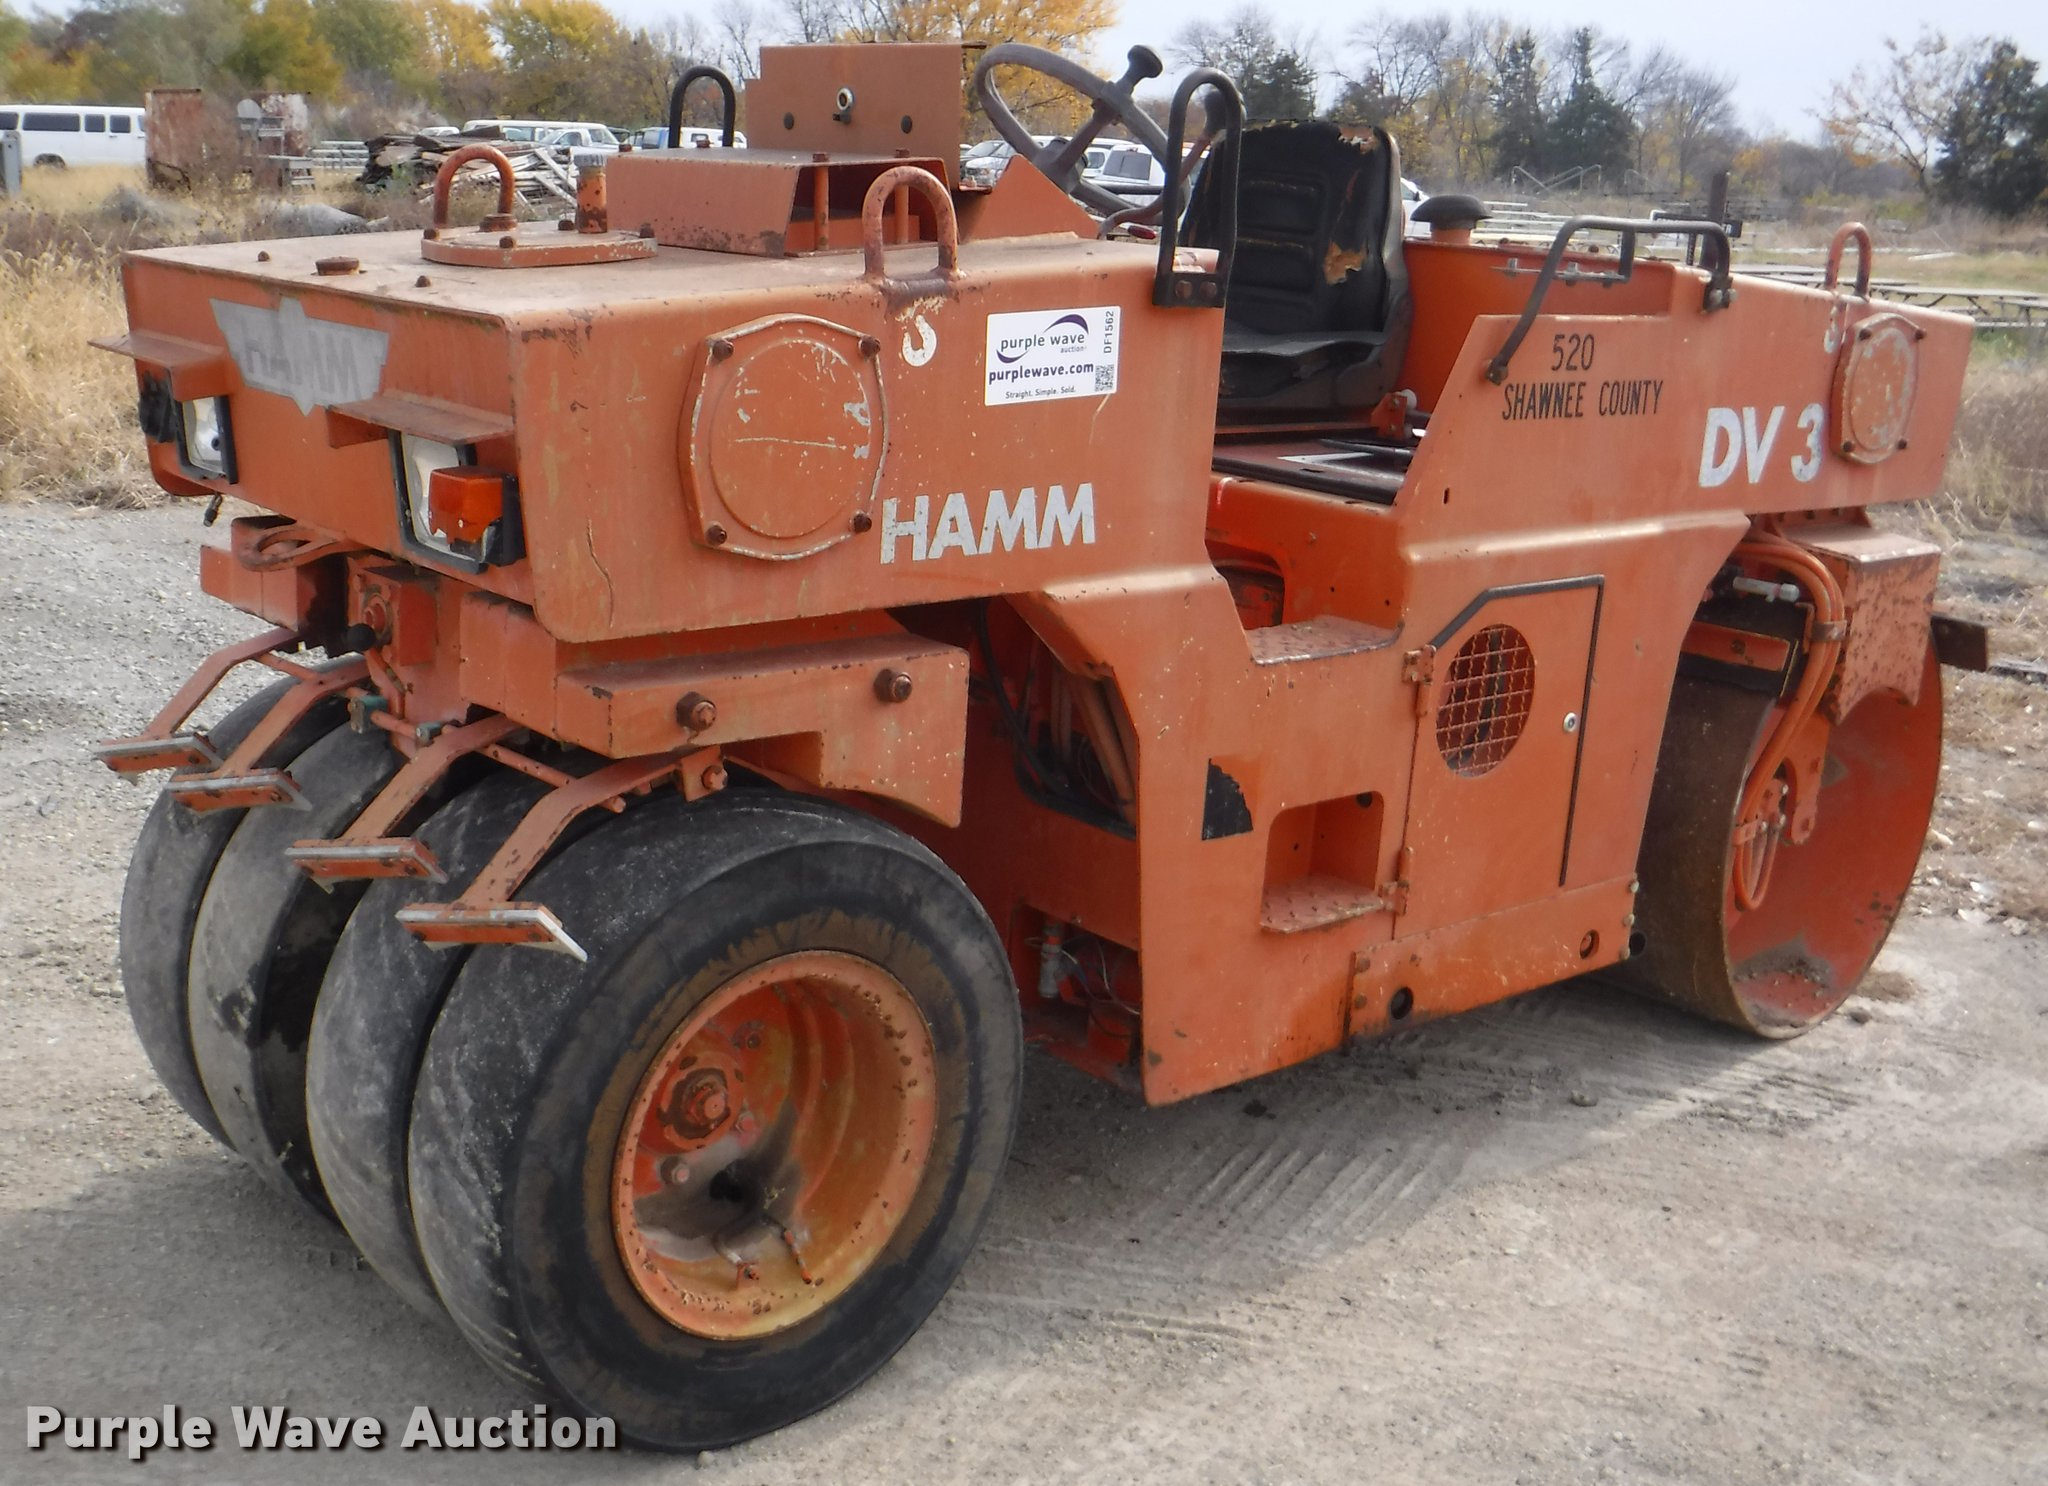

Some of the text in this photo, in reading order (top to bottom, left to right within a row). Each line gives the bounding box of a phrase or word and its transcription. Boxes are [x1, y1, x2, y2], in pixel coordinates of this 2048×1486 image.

[1000, 333, 1085, 352] purple wave
[1103, 310, 1114, 353] DF1562
[1551, 334, 1595, 371] 520
[988, 363, 1094, 384] purplewave.com
[1005, 385, 1077, 399] Straight. Simple. Sold.
[1502, 380, 1664, 420] SHAWNEE COUNTY
[1698, 403, 1824, 488] DV 3
[880, 482, 1096, 565] HAMM
